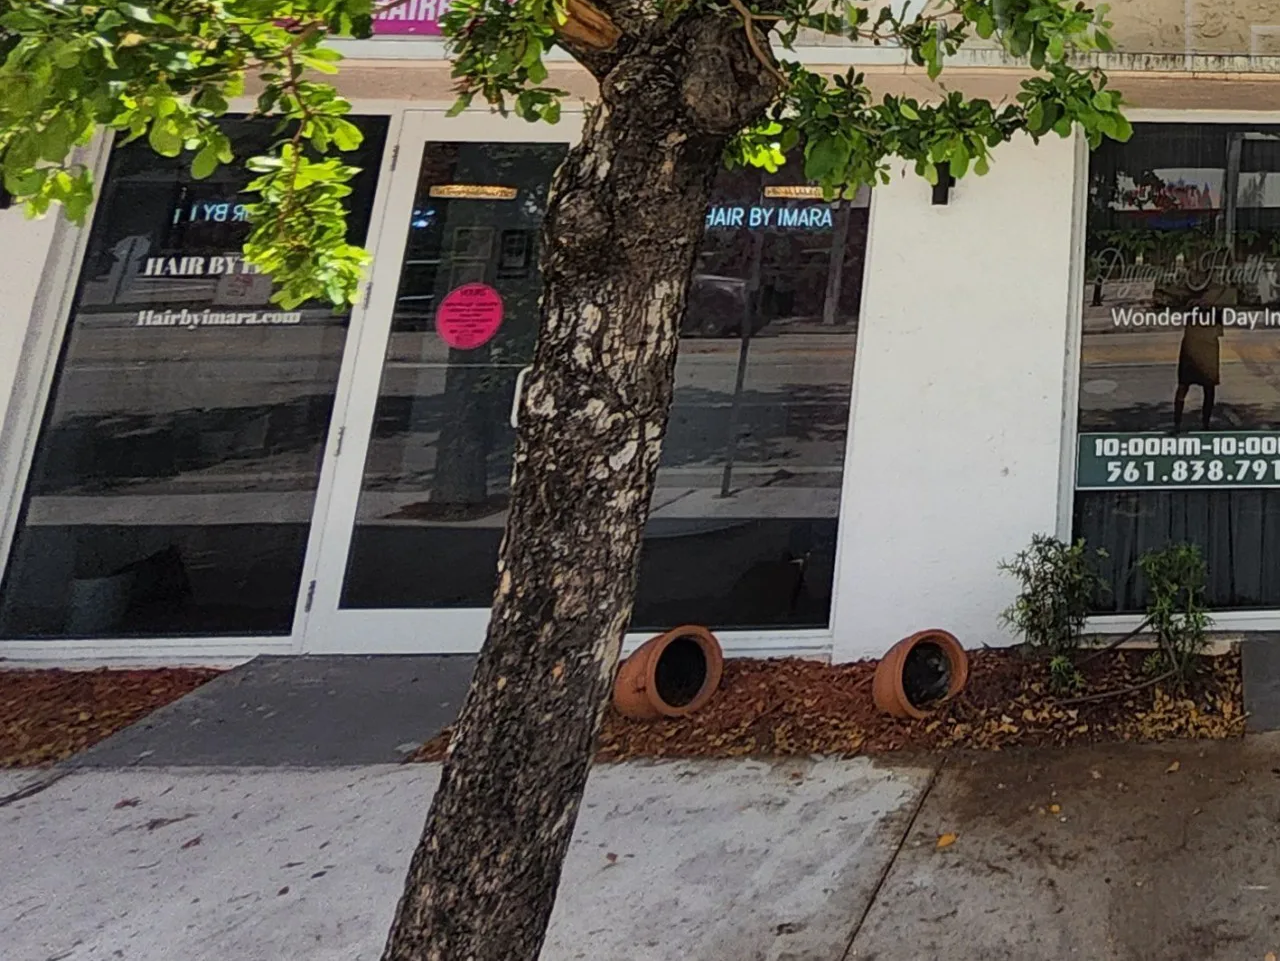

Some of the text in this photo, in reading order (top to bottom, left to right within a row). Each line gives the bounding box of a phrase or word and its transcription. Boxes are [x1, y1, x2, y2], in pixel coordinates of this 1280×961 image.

[749, 207, 774, 227] BY
[777, 207, 833, 227] IMARA
[145, 256, 203, 276] HAIR
[208, 256, 241, 275] BY
[137, 309, 302, 329] Hairbyimara.com
[1111, 306, 1217, 328] Wonderful
[1222, 308, 1262, 331] Day
